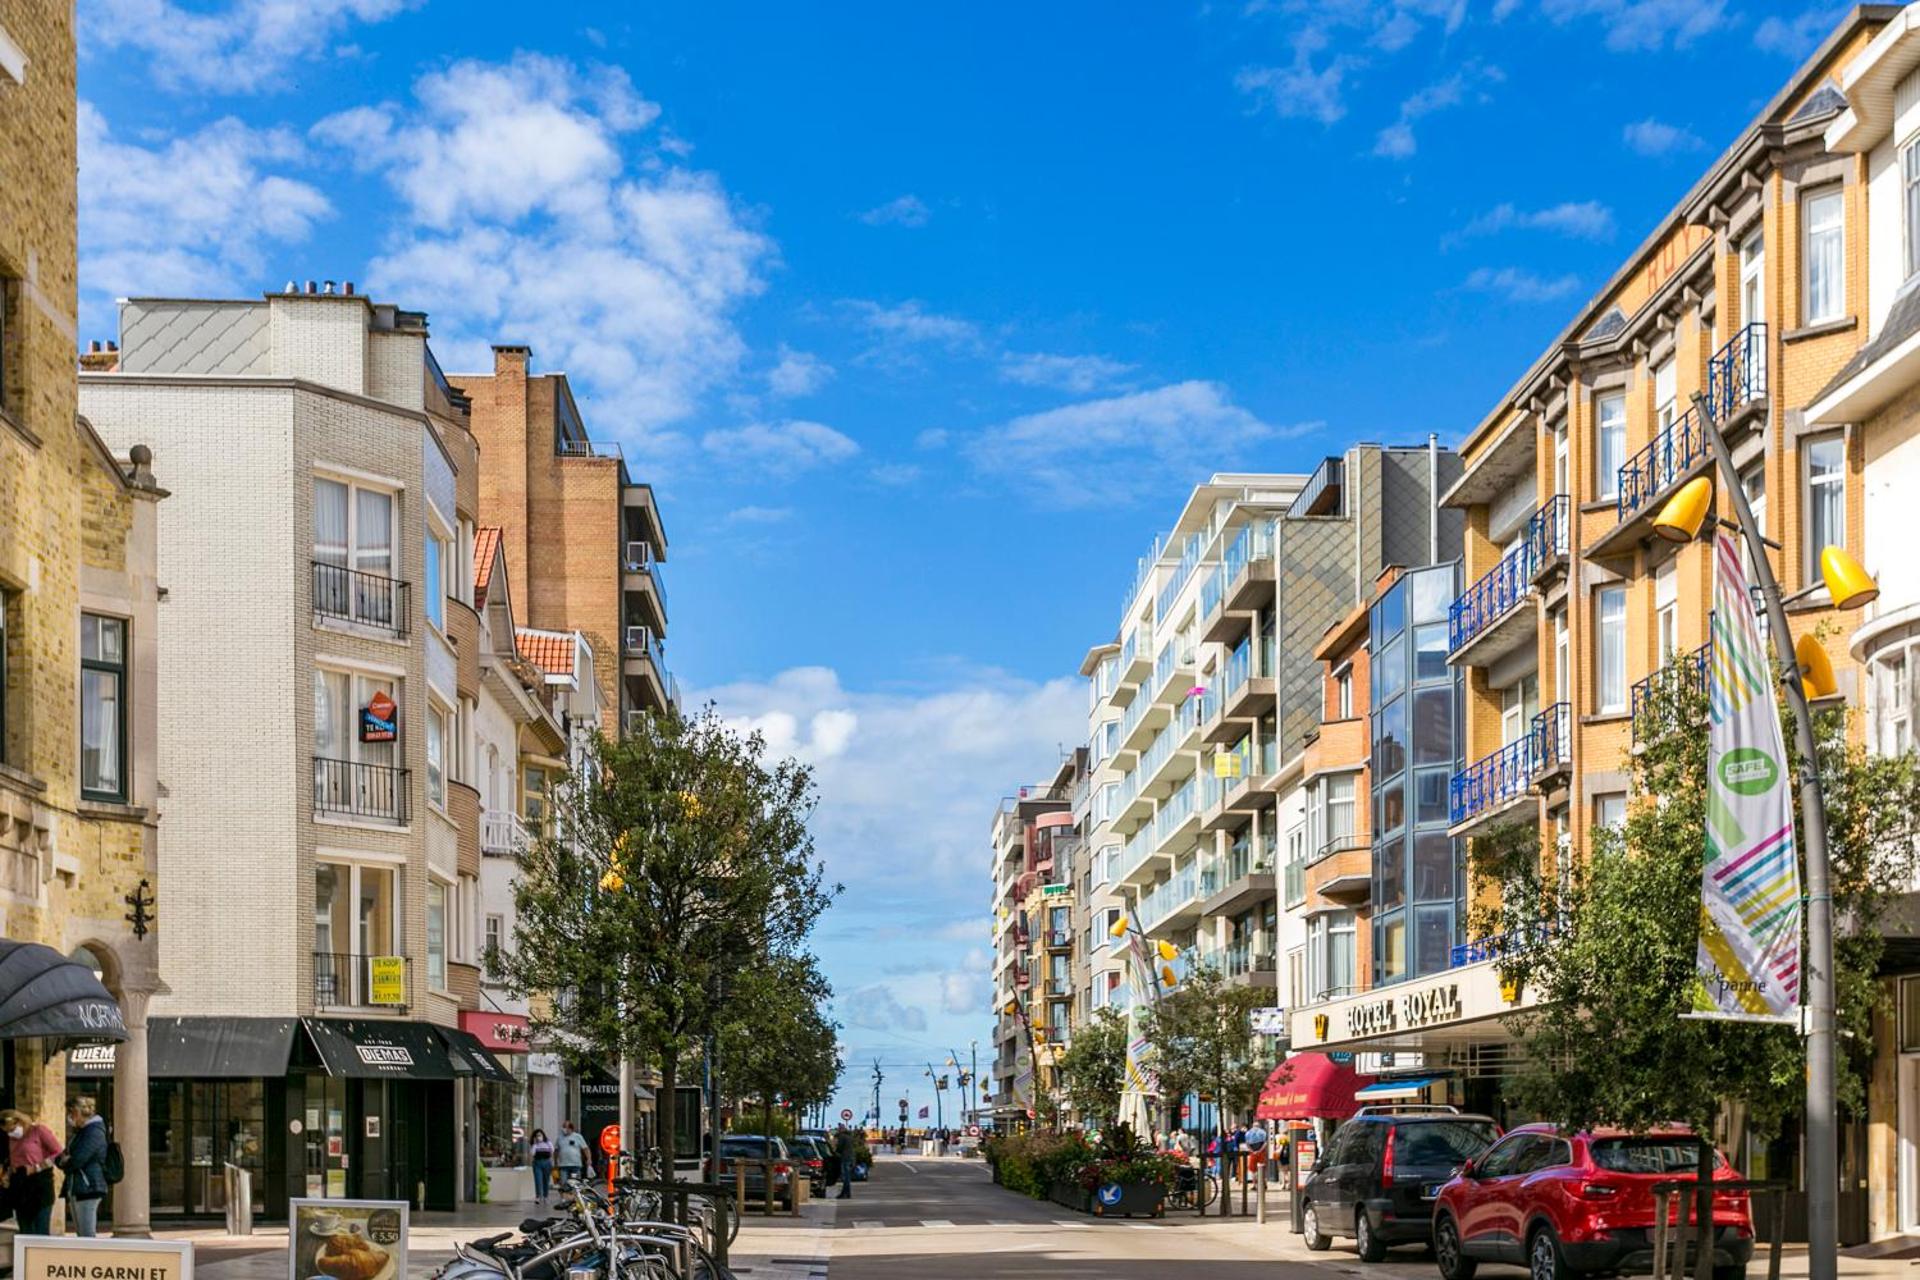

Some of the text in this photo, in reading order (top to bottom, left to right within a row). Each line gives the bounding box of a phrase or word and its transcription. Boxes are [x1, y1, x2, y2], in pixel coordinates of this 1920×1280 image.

[1727, 760, 1764, 776] SAFE
[1347, 985, 1462, 1032] HOTEL ROYAL
[361, 1048, 409, 1062] DIEMAS
[581, 1084, 620, 1095] TRAITEU
[47, 1264, 167, 1280] PAIN GARNI ET
